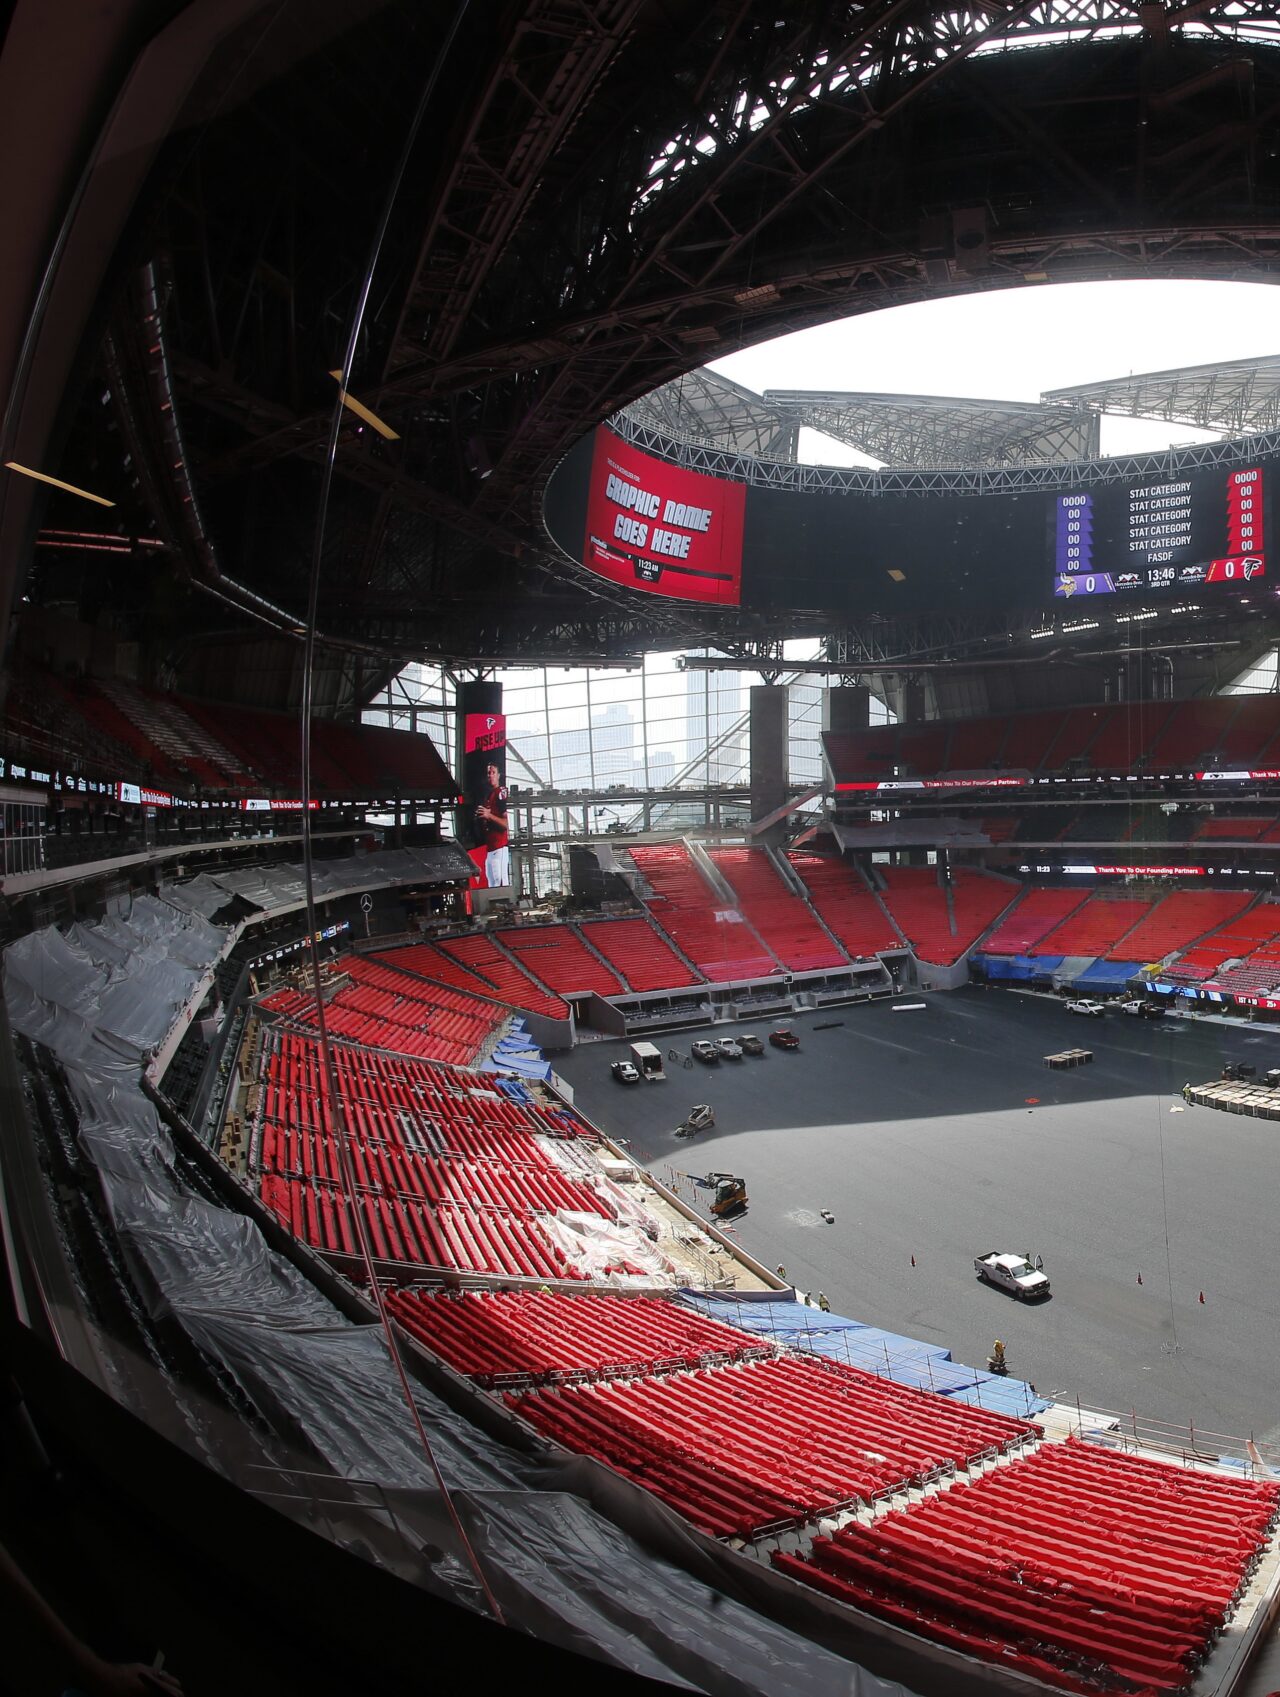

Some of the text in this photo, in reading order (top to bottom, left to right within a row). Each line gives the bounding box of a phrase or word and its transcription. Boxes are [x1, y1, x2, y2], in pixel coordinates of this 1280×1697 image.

[1235, 471, 1257, 483] 0000
[1130, 482, 1191, 498] STAT CATEGORY
[1241, 486, 1252, 496] 00
[606, 474, 712, 532] GRAPHIC NAME
[1063, 496, 1086, 506] 0000
[1130, 495, 1191, 511] STAT CATEGORY
[1241, 499, 1252, 510] 00
[1068, 509, 1080, 519] 00
[1130, 508, 1191, 524] STAT CATEGORY
[1241, 513, 1252, 523] 00
[1068, 522, 1080, 531] 00
[1130, 522, 1191, 538] STAT CATEGORY
[1241, 527, 1252, 537] 00
[614, 514, 648, 547] GOES
[651, 528, 691, 558] HERE
[1068, 535, 1080, 544] 00
[1130, 535, 1191, 551] STAT CATEGORY
[1241, 540, 1252, 551] 00
[1068, 547, 1080, 557] 00
[1148, 551, 1173, 562] FASDF
[1068, 560, 1080, 570] 00
[1225, 562, 1234, 578] 0
[1147, 568, 1175, 581] 13:46
[1086, 577, 1095, 592] 0
[1238, 996, 1246, 1004] 1ST
